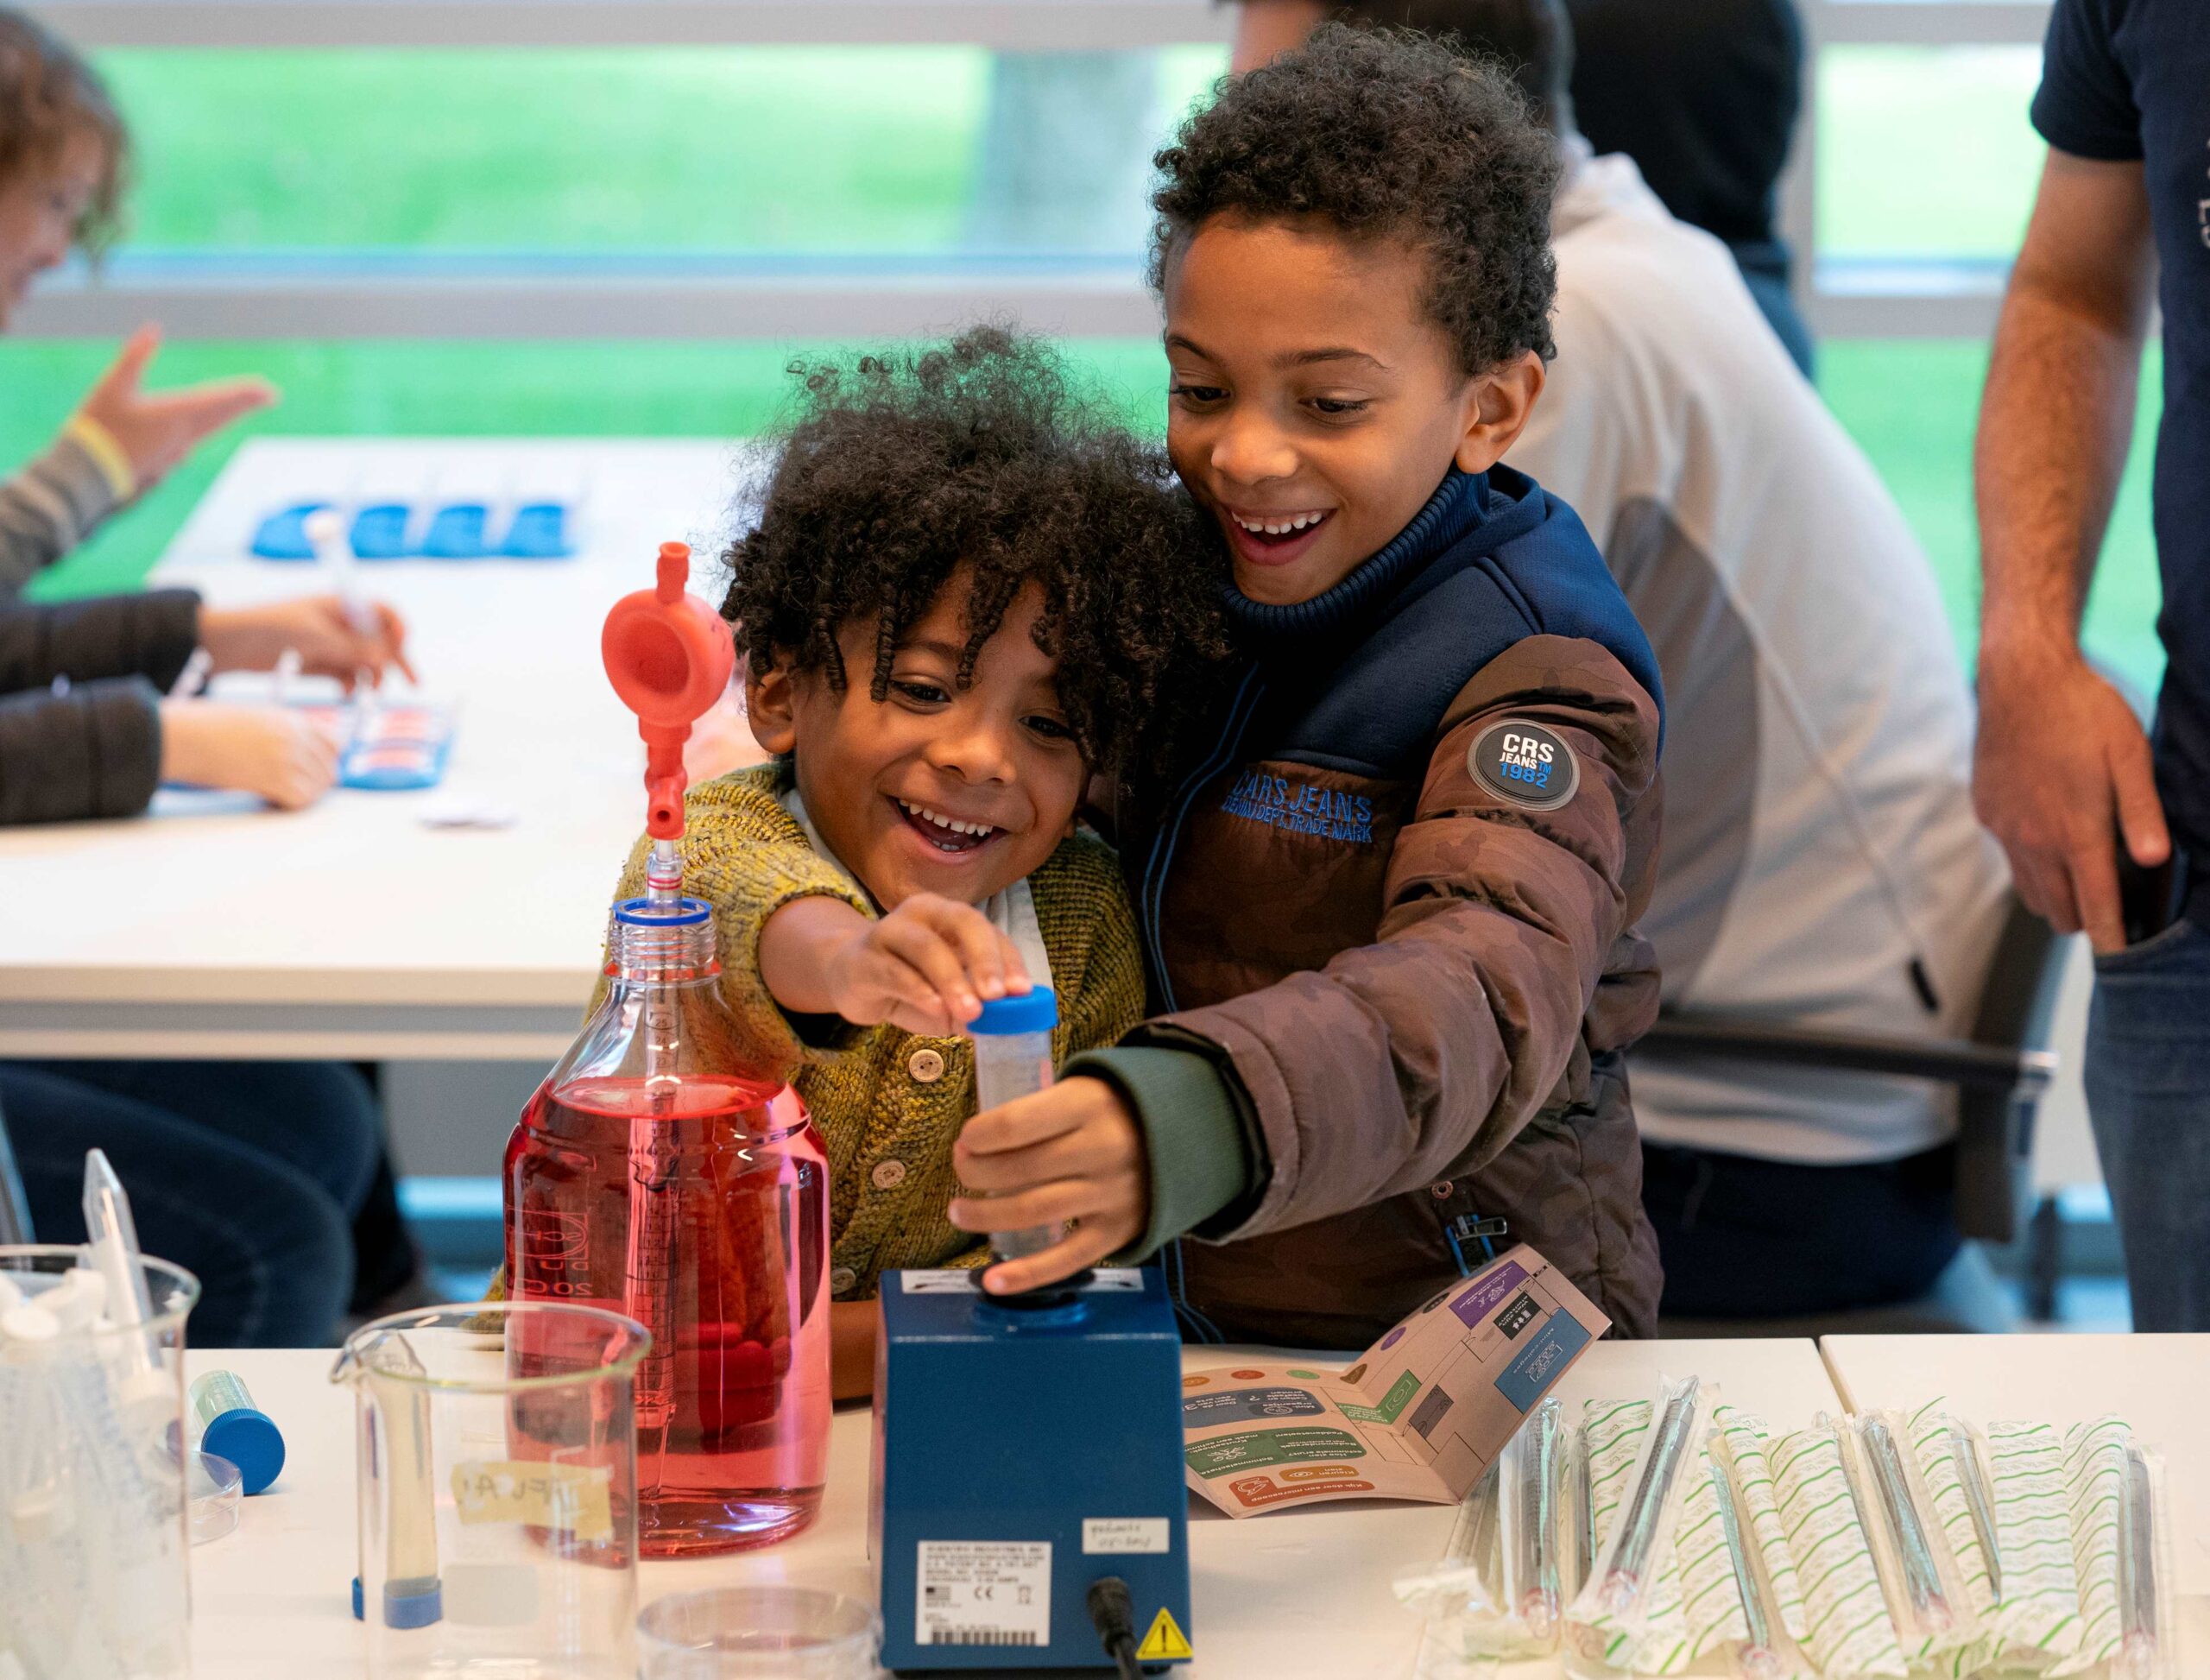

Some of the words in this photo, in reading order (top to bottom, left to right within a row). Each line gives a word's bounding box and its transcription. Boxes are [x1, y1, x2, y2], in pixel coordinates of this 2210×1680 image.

[1499, 752, 1538, 769] JEANS
[1503, 734, 1554, 763] CRS
[1500, 762, 1548, 789] 1982
[1230, 770, 1288, 806] CARS
[1287, 784, 1373, 824] JEANS
[1289, 812, 1330, 836] TRADE
[1331, 821, 1373, 843] MARK
